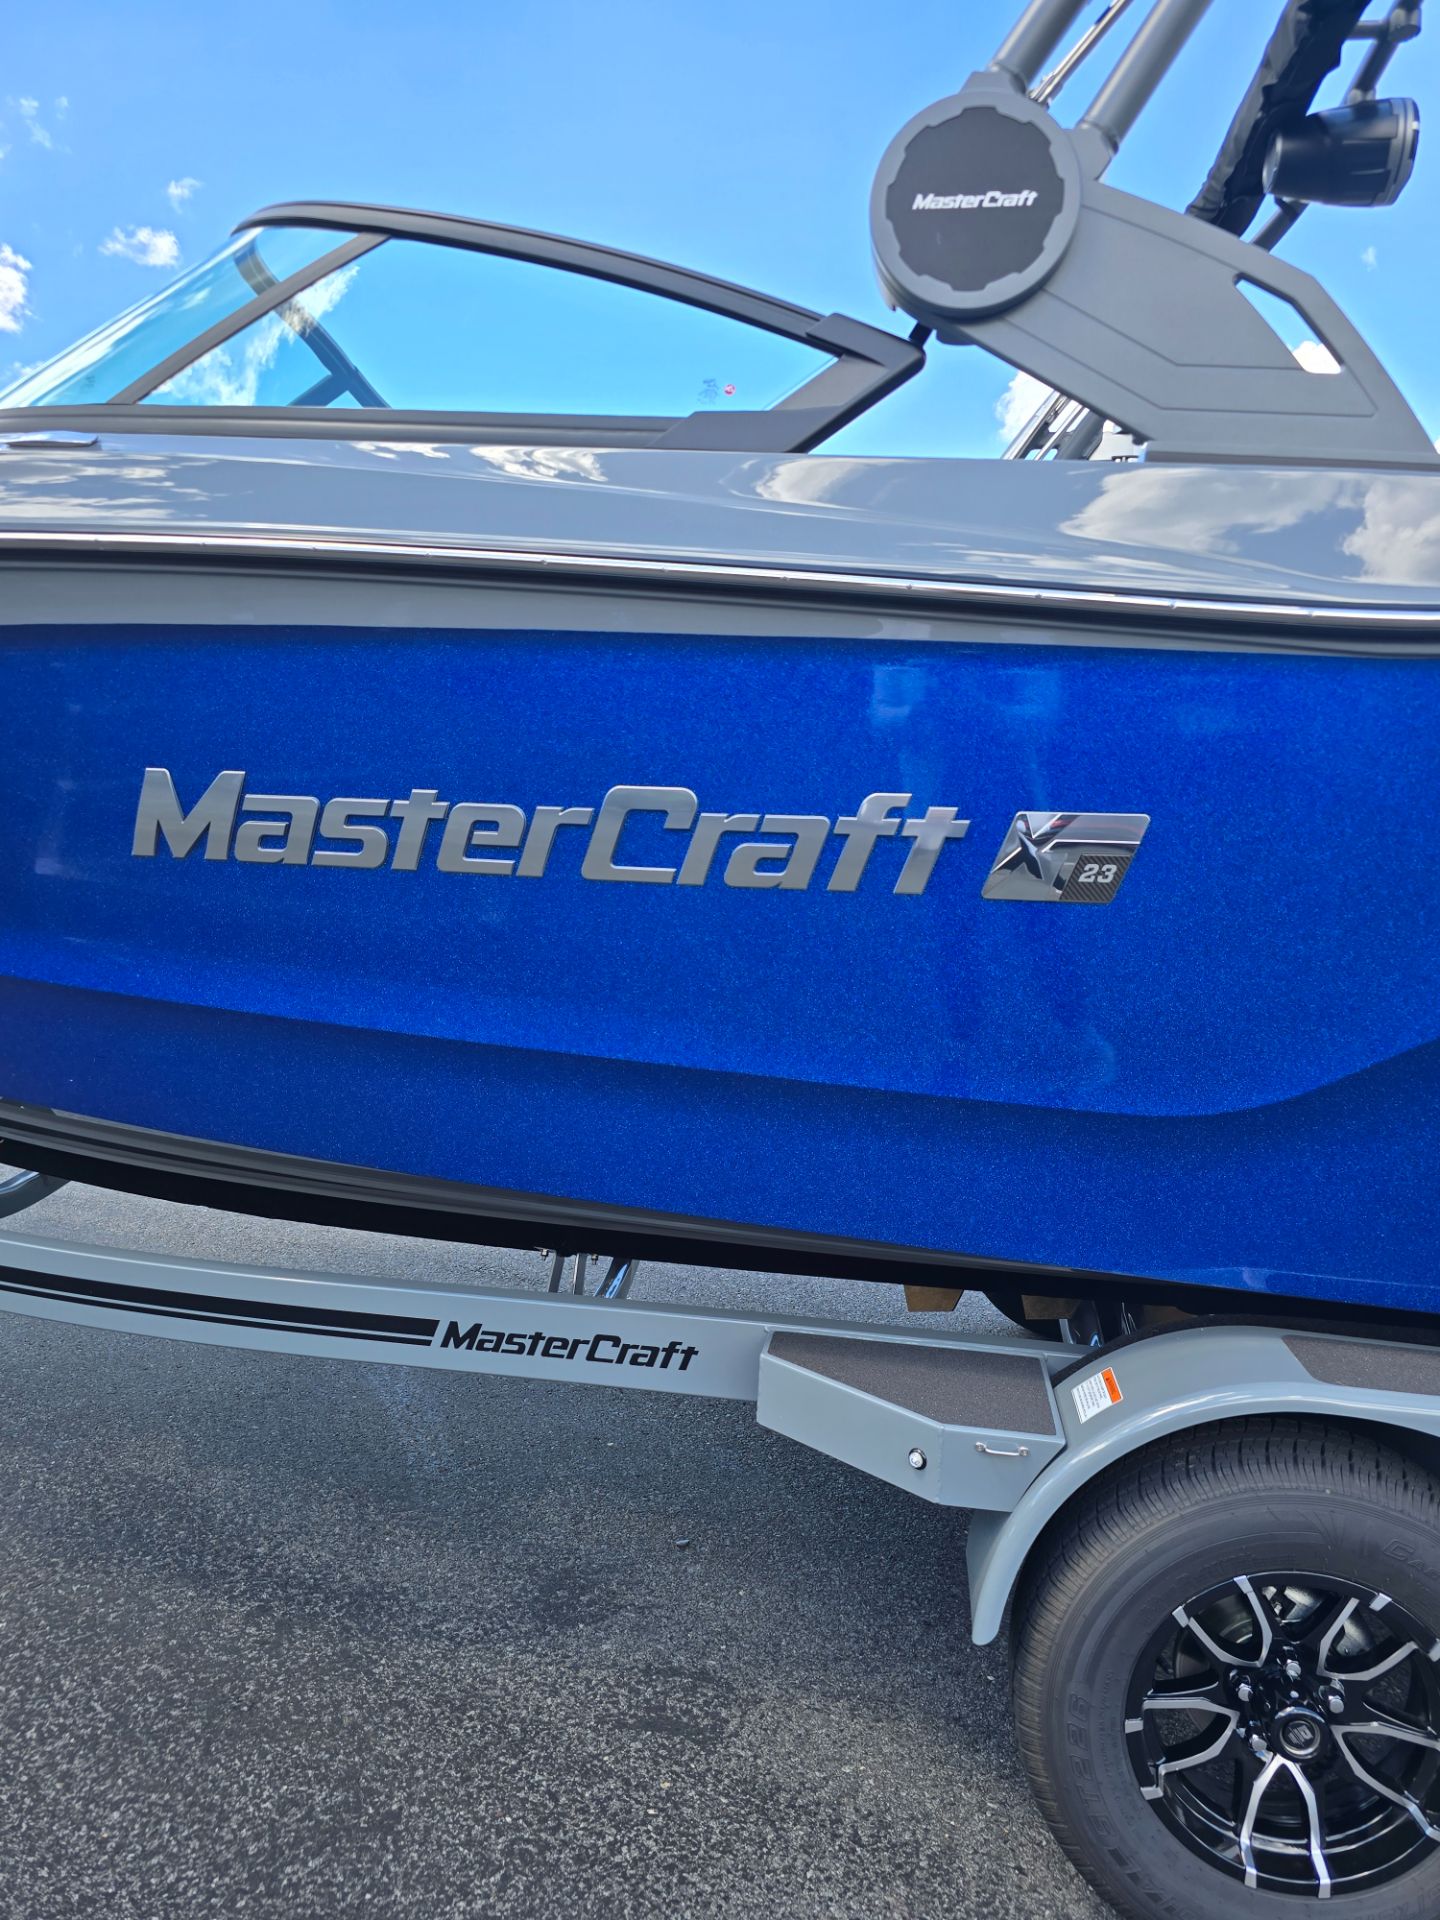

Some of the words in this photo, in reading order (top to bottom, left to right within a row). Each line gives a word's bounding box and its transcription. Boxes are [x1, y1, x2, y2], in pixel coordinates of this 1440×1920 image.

[912, 190, 1038, 210] MasterCraft
[131, 767, 970, 896] MasterCraft
[1078, 863, 1118, 883] 23
[440, 1320, 699, 1371] MasterCraft
